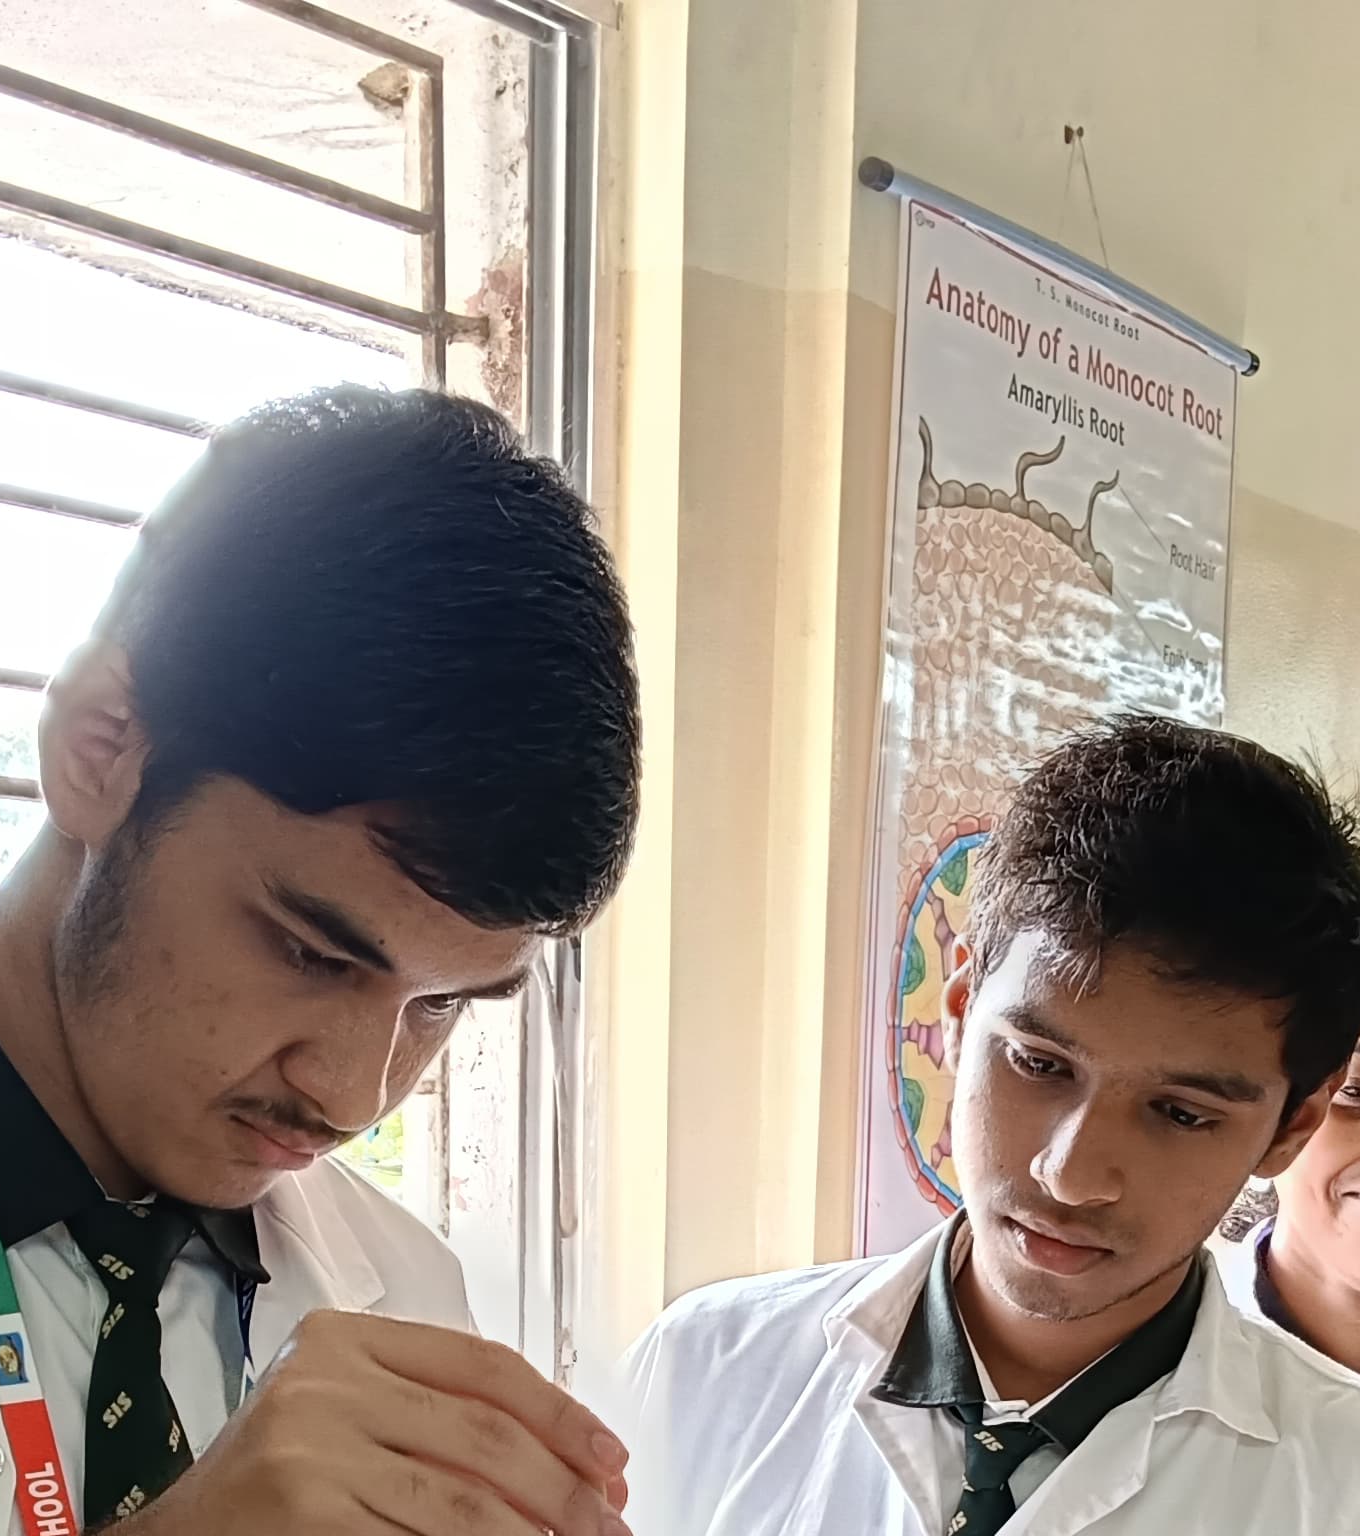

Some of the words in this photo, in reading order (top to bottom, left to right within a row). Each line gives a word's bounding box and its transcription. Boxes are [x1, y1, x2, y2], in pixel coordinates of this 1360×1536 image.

[1065, 294, 1110, 328] Monocot
[1113, 318, 1140, 341] Root
[926, 266, 1031, 358] Anatomy
[1038, 327, 1062, 364] of
[1068, 344, 1079, 375] a
[1086, 345, 1174, 417] Monocot
[1182, 387, 1222, 440] Root
[1008, 373, 1084, 430] Amaryllis
[1090, 407, 1125, 446] Root
[1170, 544, 1193, 573] Root
[1194, 554, 1216, 582] Hair
[98, 1253, 134, 1281] SIS
[102, 1303, 125, 1340] SIS
[102, 1391, 133, 1429] SIS
[973, 1431, 1004, 1452] SIS
[116, 1485, 145, 1520] SIS
